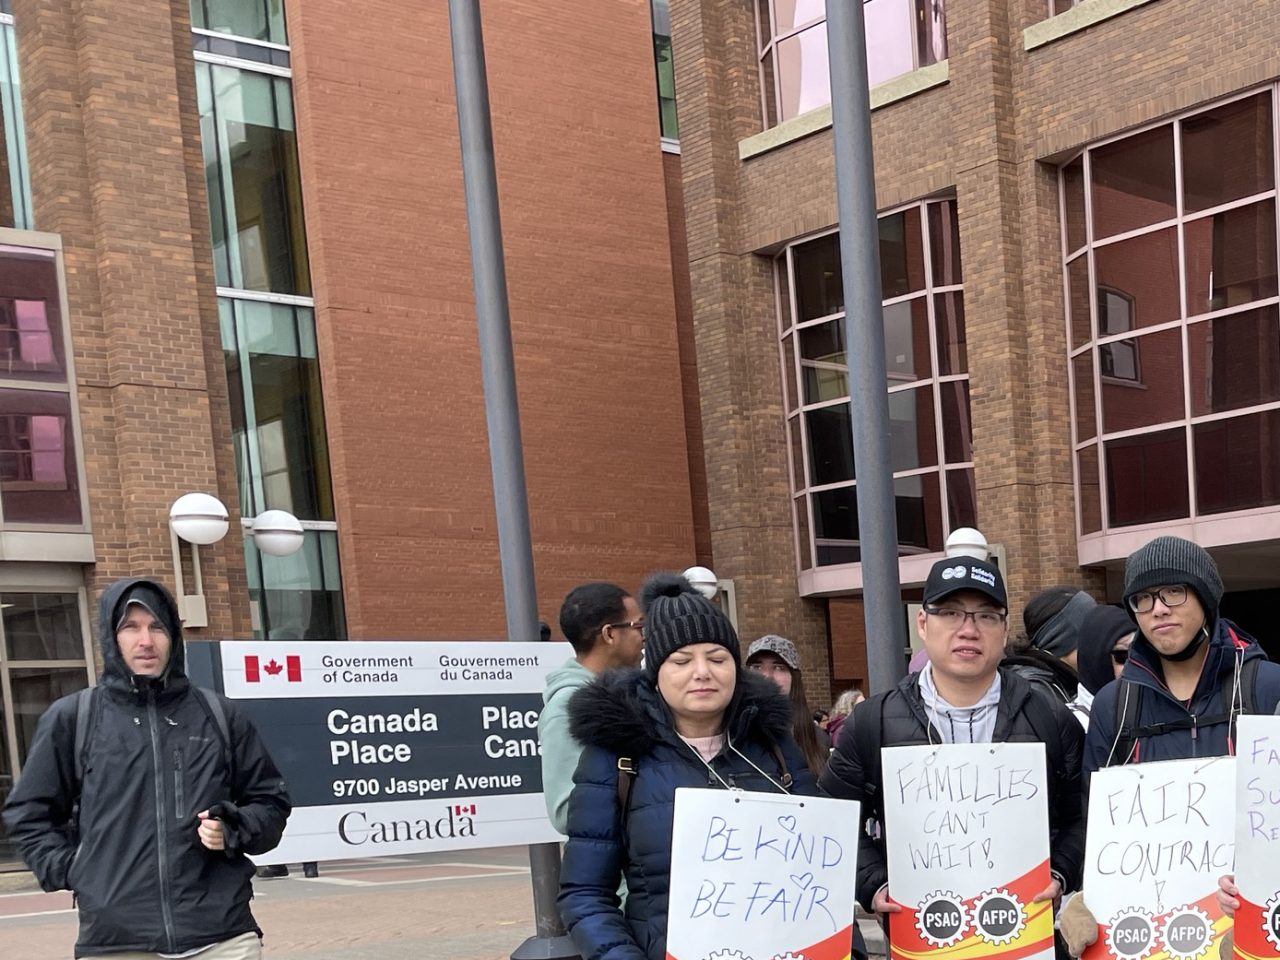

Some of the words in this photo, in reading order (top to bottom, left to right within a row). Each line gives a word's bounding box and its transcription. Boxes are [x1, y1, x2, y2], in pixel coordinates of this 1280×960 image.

[322, 655, 413, 668] Government
[439, 655, 539, 667] Gouvernement
[323, 670, 338, 683] of
[343, 670, 398, 682] Canada
[440, 669, 458, 681] du
[462, 669, 513, 681] Canada
[327, 708, 439, 735] Canada
[482, 706, 539, 729] Plac
[330, 740, 412, 765] Place
[484, 734, 542, 759] Can
[332, 778, 380, 797] 9700
[384, 776, 449, 797] Jasper
[454, 773, 522, 790] Avenue
[897, 762, 1039, 805] FAMILIES
[1107, 780, 1210, 827] FAIR
[338, 806, 477, 845] Canada
[923, 811, 989, 836] CAN'T
[702, 816, 743, 862] BE
[690, 879, 736, 919] BE
[744, 872, 837, 932] FAIR
[926, 912, 959, 928] PSAC
[982, 910, 1017, 926] AFPC
[1116, 928, 1149, 944] PSAC
[1170, 925, 1204, 942] AFPC
